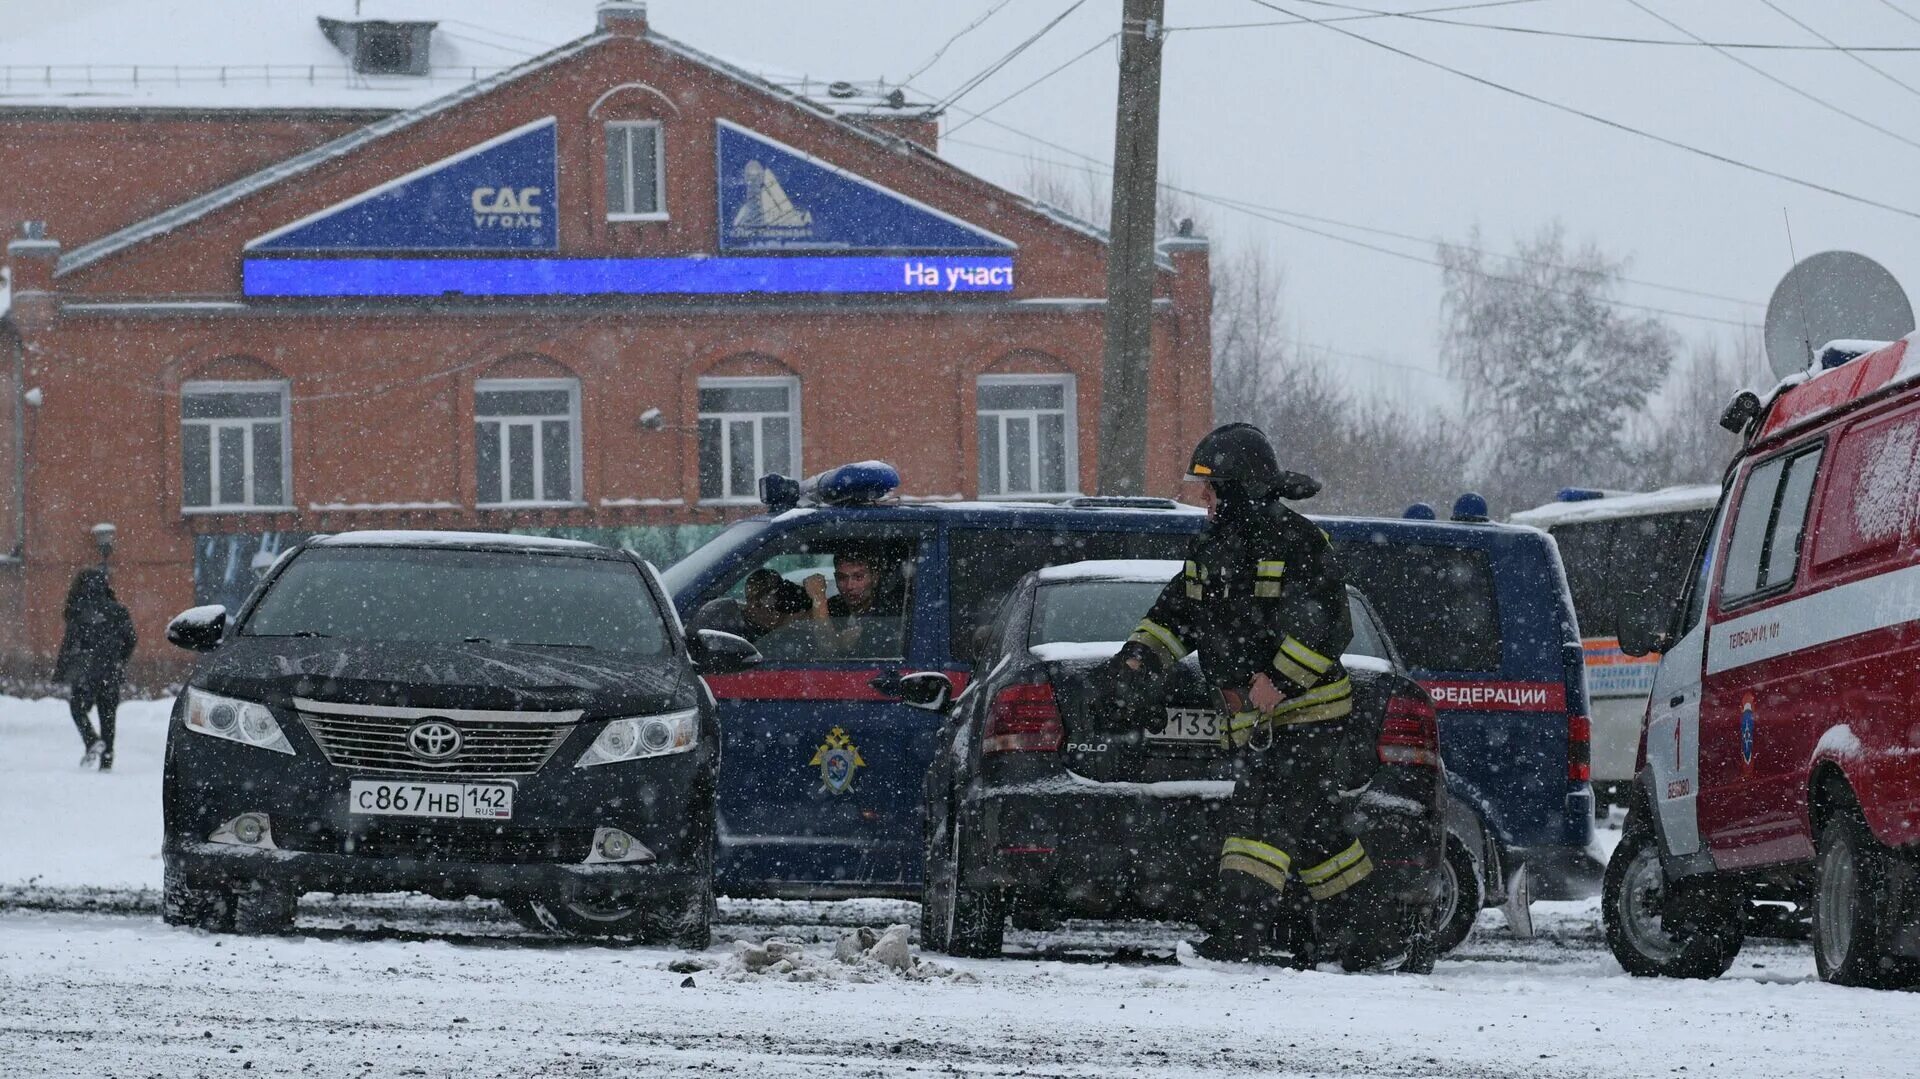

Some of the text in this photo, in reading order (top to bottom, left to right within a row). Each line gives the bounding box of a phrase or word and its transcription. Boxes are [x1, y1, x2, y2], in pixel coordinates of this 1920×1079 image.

[904, 262, 939, 286] На
[1729, 626, 1759, 650] ТЕЛЕФОН
[1769, 621, 1780, 639] 101
[1430, 687, 1547, 705] ФЕДЕРАЦИИ
[1162, 711, 1217, 737] 133
[1066, 743, 1108, 752] POLO
[467, 787, 506, 808] 142
[475, 808, 495, 817] RUS
